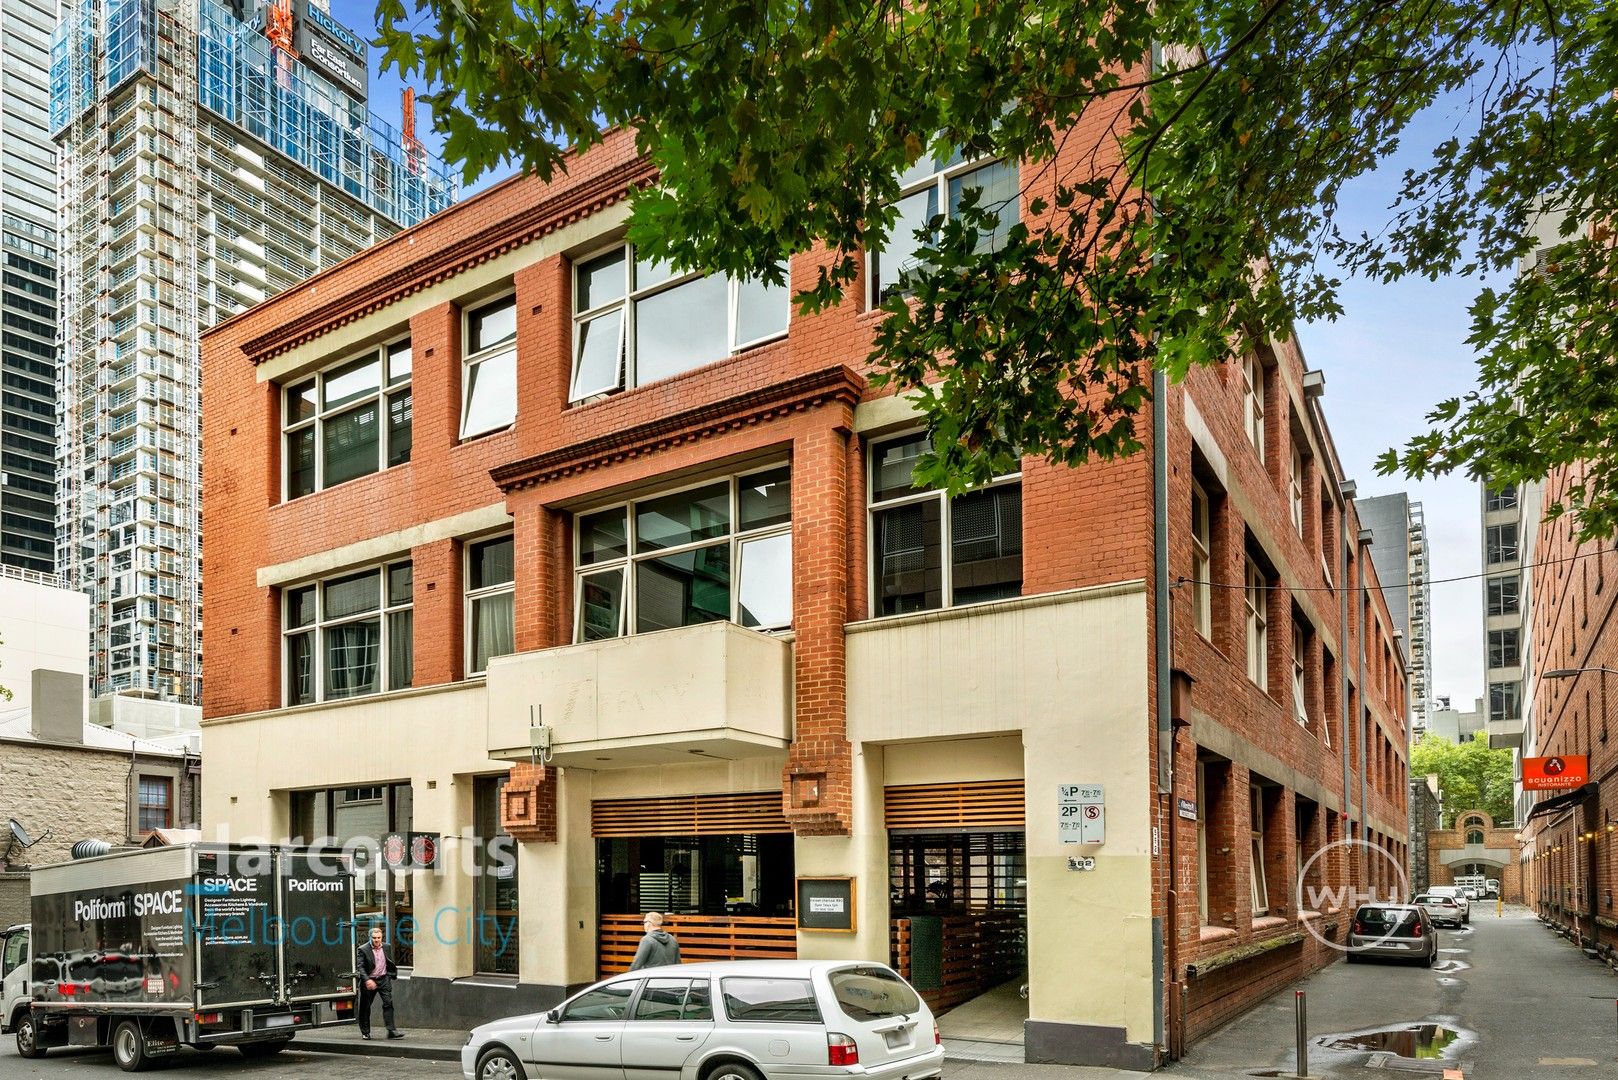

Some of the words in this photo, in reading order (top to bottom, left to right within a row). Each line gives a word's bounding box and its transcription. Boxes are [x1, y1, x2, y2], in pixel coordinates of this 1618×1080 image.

[311, 38, 326, 54] Far
[327, 50, 346, 70] East
[311, 48, 362, 90] Consortium
[1062, 806, 1078, 816] 2P
[204, 878, 257, 892] SPACE
[288, 879, 343, 892] Poliform
[75, 898, 126, 921] Poliform
[134, 890, 182, 916] SPACE
